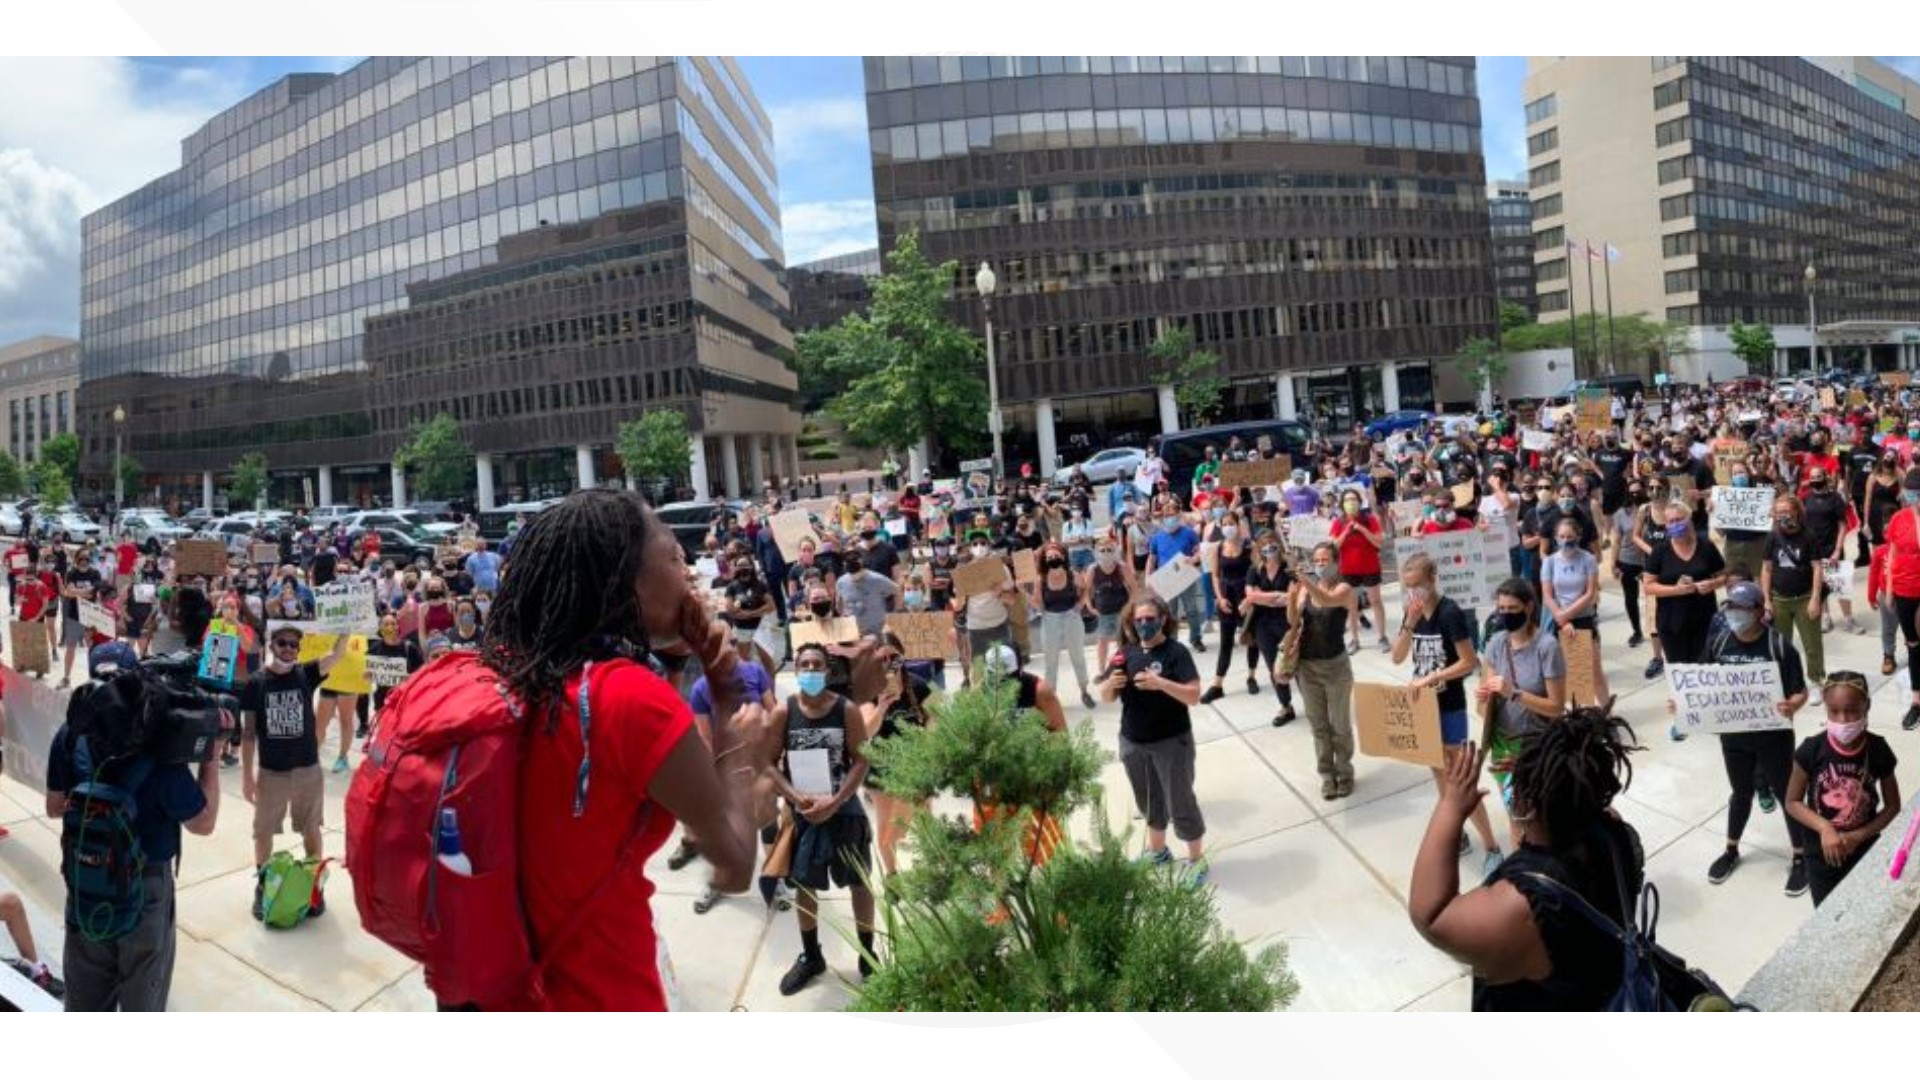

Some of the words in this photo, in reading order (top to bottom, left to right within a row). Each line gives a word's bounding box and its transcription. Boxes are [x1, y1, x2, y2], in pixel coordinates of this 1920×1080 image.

[1719, 489, 1766, 502] POLICE
[1730, 503, 1760, 515] FREE
[1672, 669, 1774, 691] DECOLONIZE
[267, 689, 302, 707] BLACK
[1685, 690, 1772, 708] EDUCATION
[266, 705, 303, 722] LIVES
[1686, 711, 1700, 725] IN
[267, 720, 304, 736] MATTER
